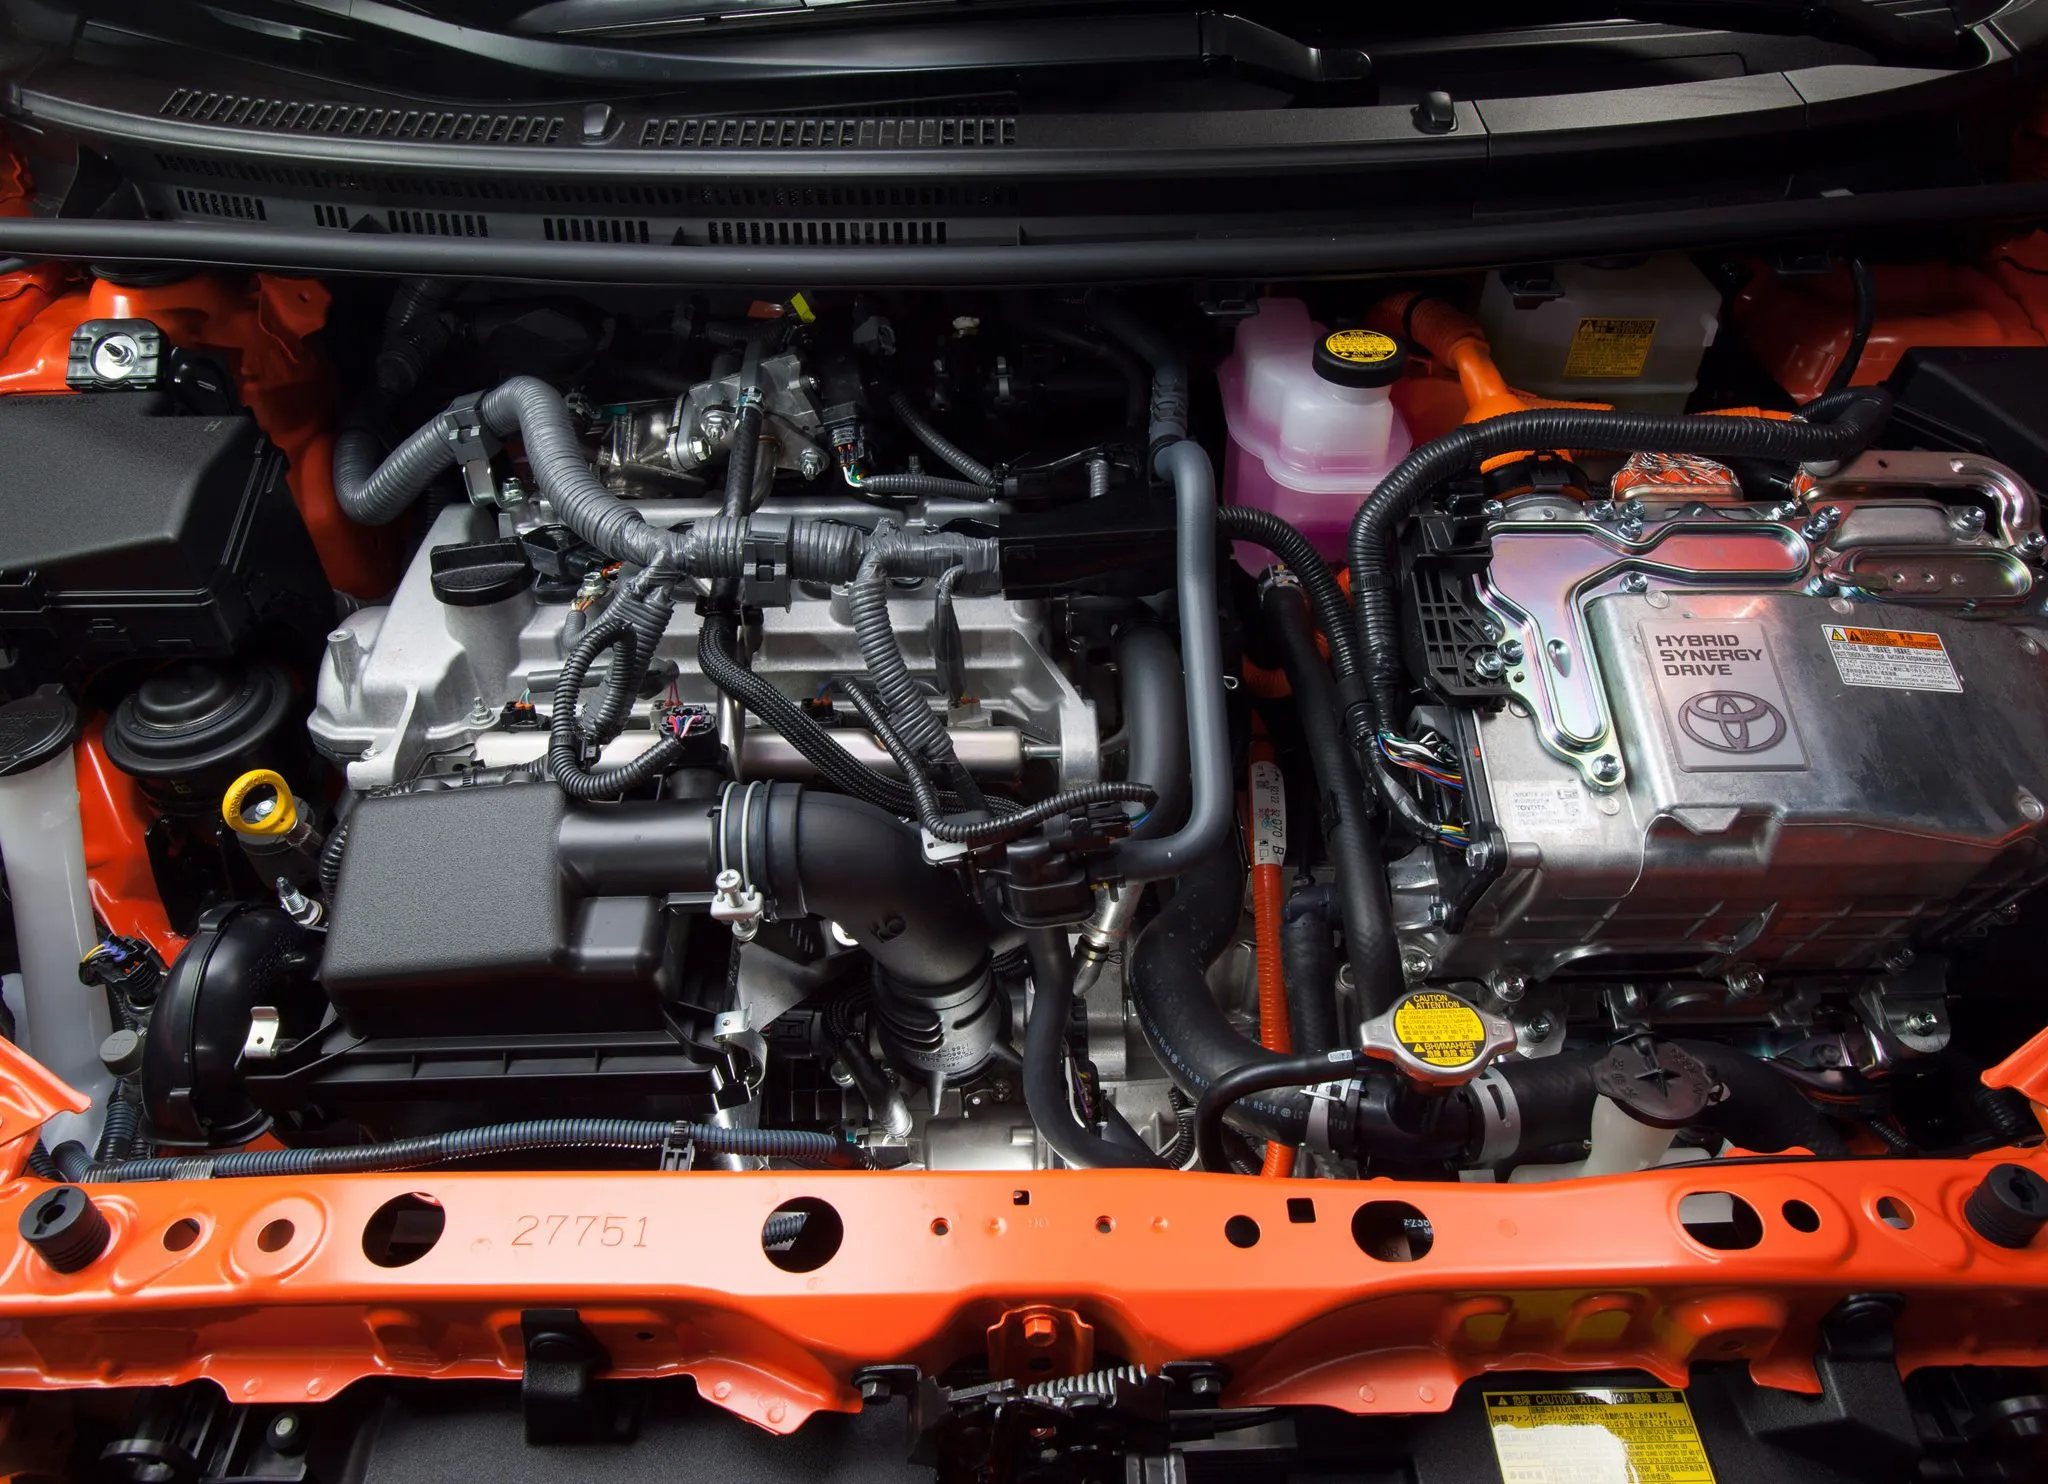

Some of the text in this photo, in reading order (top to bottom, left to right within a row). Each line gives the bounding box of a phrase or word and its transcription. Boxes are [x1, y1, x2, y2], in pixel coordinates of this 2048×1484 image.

[1656, 635, 1740, 646] HYBRID
[1660, 649, 1762, 662] SYNERGY
[1664, 664, 1732, 676] DRIVE
[1424, 1042, 1476, 1050] ВНИМАНИЕ!
[511, 1215, 648, 1247] 27751
[1536, 1395, 1575, 1404] CAUTION
[1492, 1414, 1530, 1422] 冷却ファン
